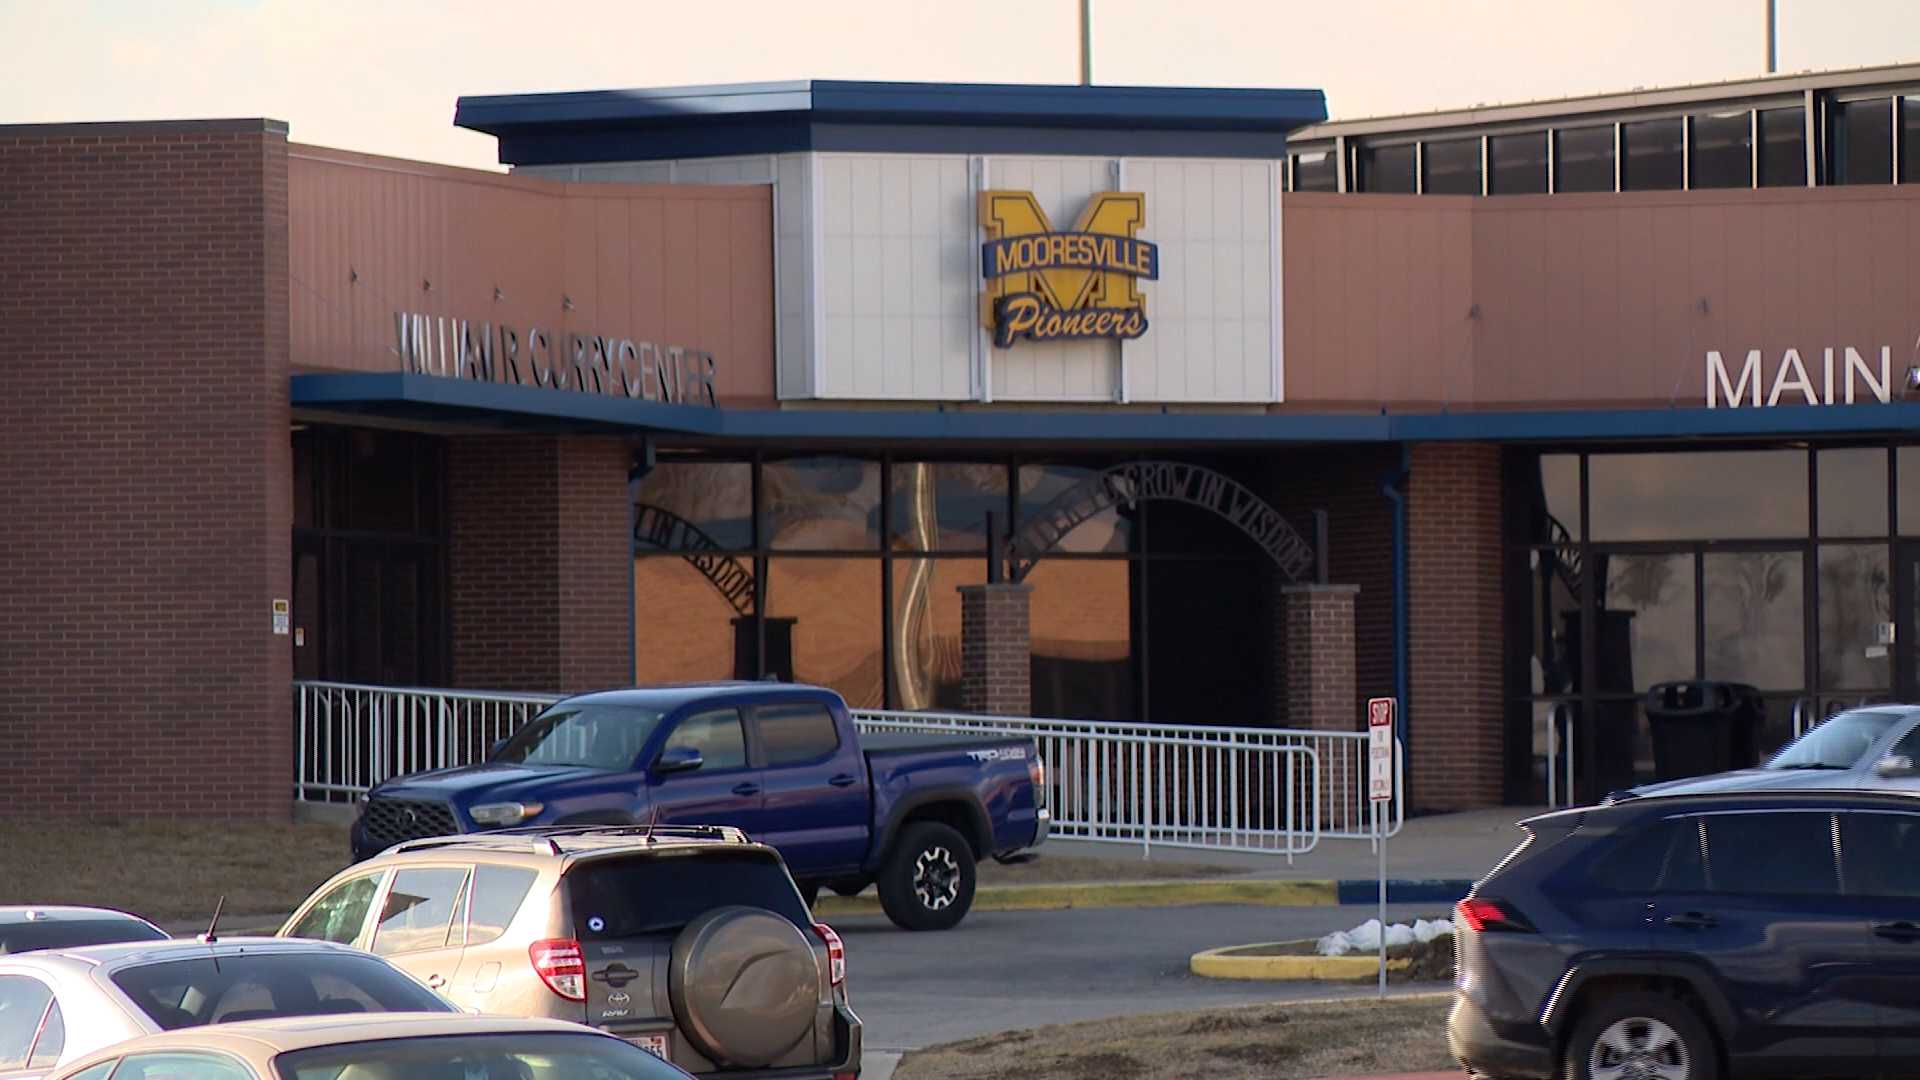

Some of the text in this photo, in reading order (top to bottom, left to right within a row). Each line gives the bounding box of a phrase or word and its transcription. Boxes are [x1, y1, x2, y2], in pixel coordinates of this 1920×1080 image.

[996, 236, 1151, 273] MOORESVILLE
[1007, 297, 1140, 344] Pioneers
[529, 327, 616, 396] CURRY
[618, 338, 720, 409] CENTER
[1706, 346, 1890, 409] MAIN
[1123, 463, 1193, 500] GROW
[1197, 470, 1226, 509] IN
[1226, 484, 1315, 579] WISDOM
